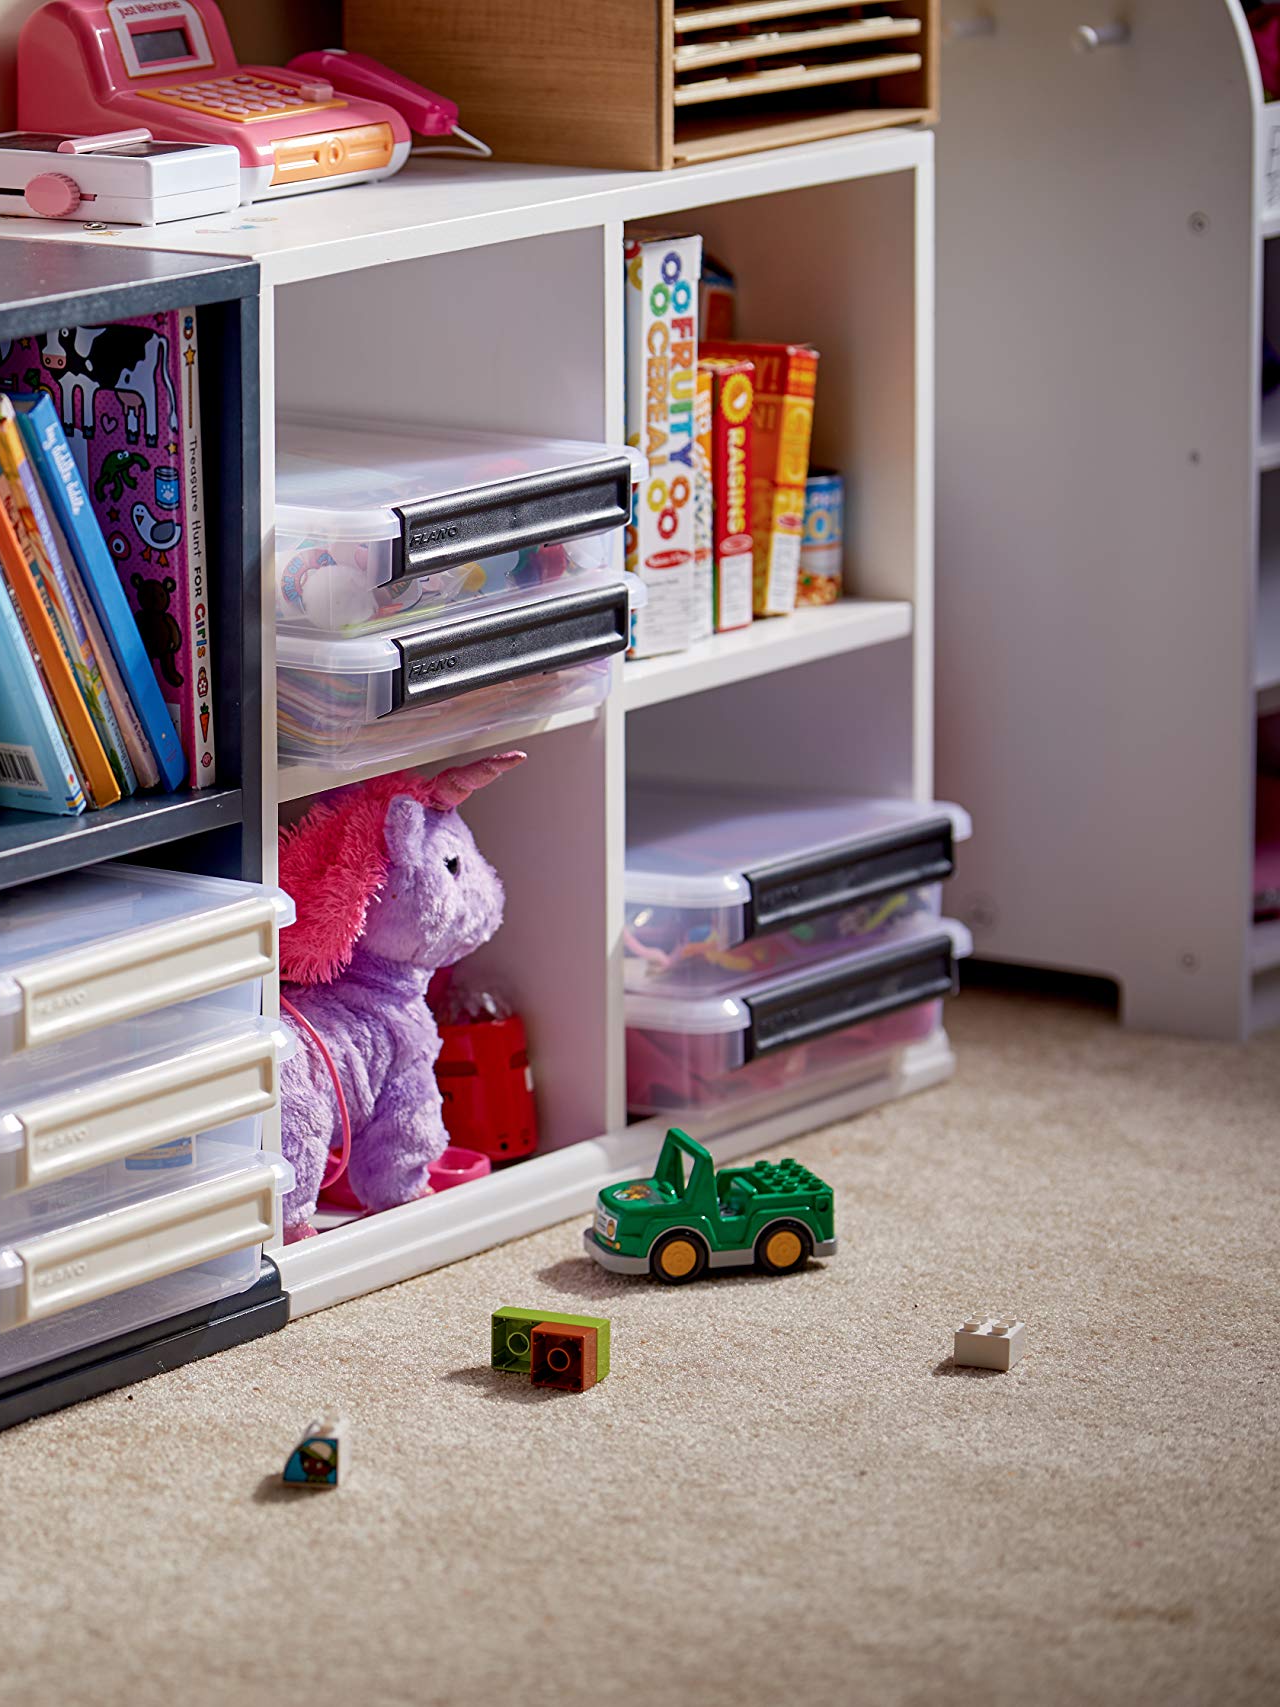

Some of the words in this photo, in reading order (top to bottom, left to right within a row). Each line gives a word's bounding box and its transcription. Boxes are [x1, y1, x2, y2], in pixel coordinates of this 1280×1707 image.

[647, 321, 669, 466] CEREAL
[670, 316, 694, 468] FRUITY
[189, 436, 198, 512] Treasure
[727, 426, 746, 534] RAISINS
[192, 520, 202, 557] Hunt
[194, 566, 202, 598] FOR
